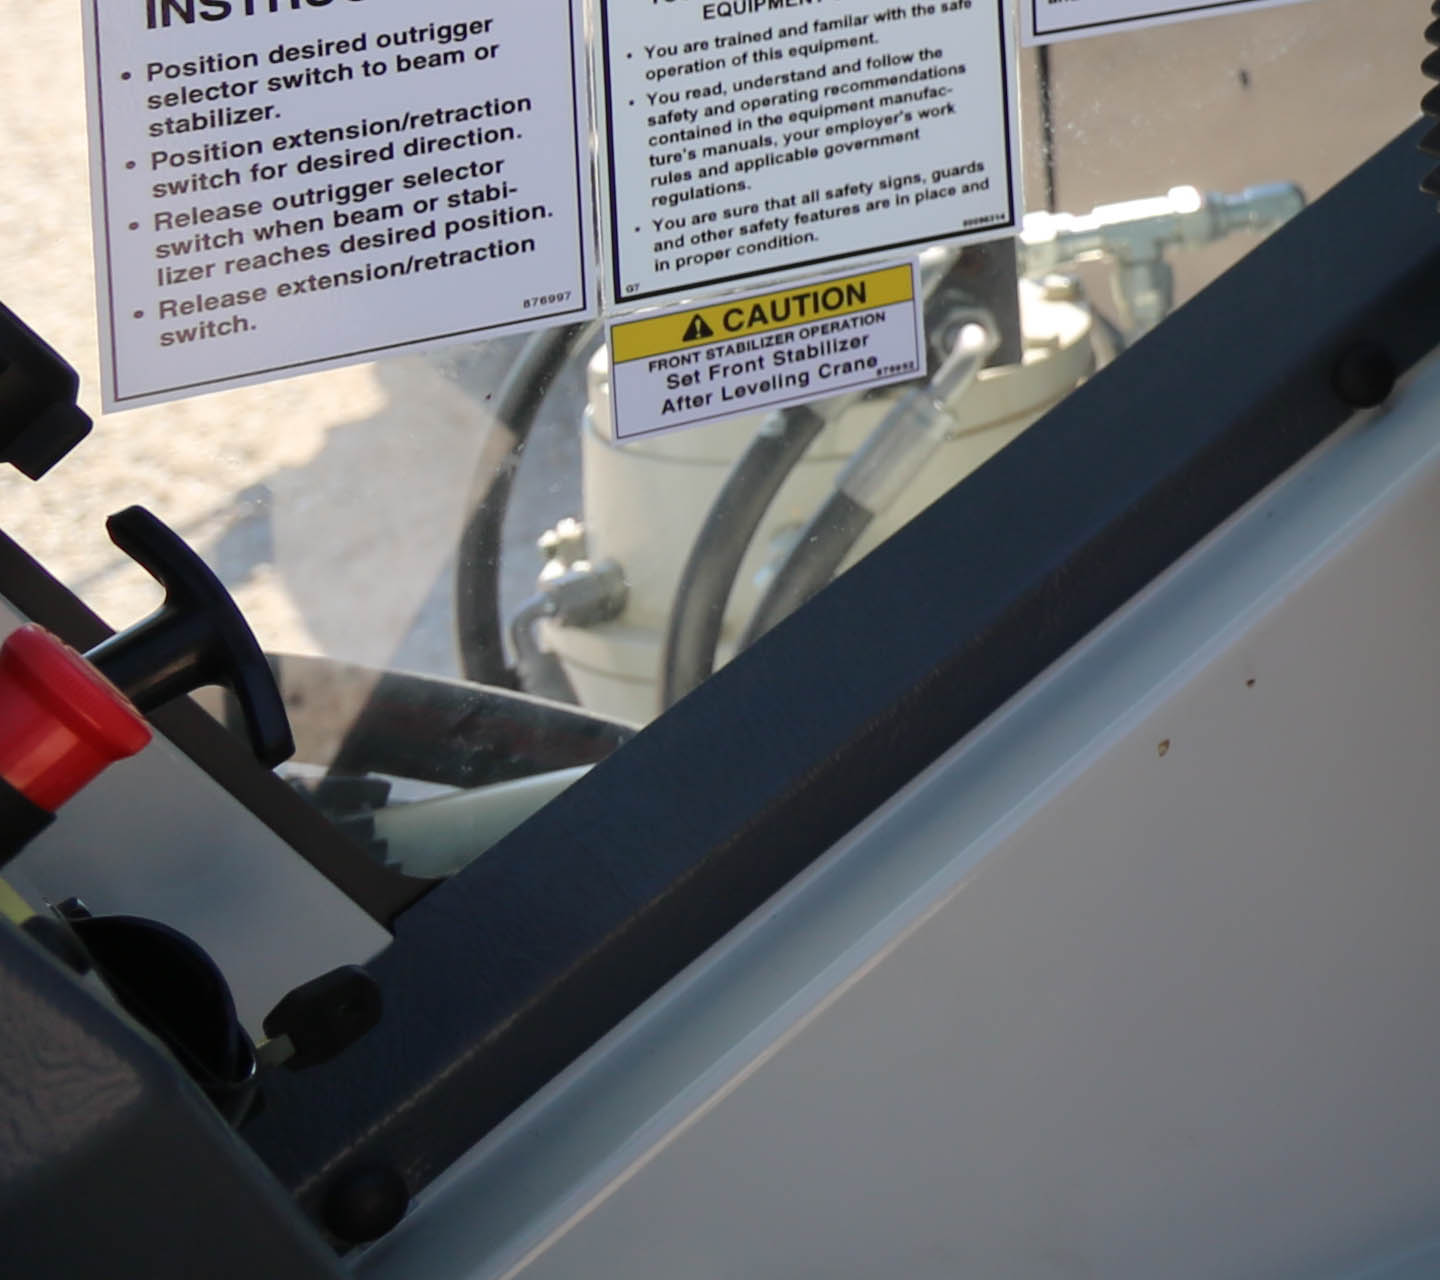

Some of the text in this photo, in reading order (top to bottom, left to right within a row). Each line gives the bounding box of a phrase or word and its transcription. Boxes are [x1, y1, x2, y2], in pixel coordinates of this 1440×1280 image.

[146, 18, 493, 82] Position desired outrigger
[147, 43, 499, 110] selector switch to beam or
[148, 104, 281, 137] stabilizer.
[151, 97, 532, 170] Position extension/retraction
[152, 126, 522, 198] switch for desired direction.
[723, 281, 867, 333] CAUTION
[647, 310, 886, 373] FRONT STABILIZER OPERATION
[666, 334, 869, 390] Set Front Stabilizer
[661, 392, 712, 415] After
[720, 370, 810, 402] Leveling
[817, 355, 878, 379] Crane
